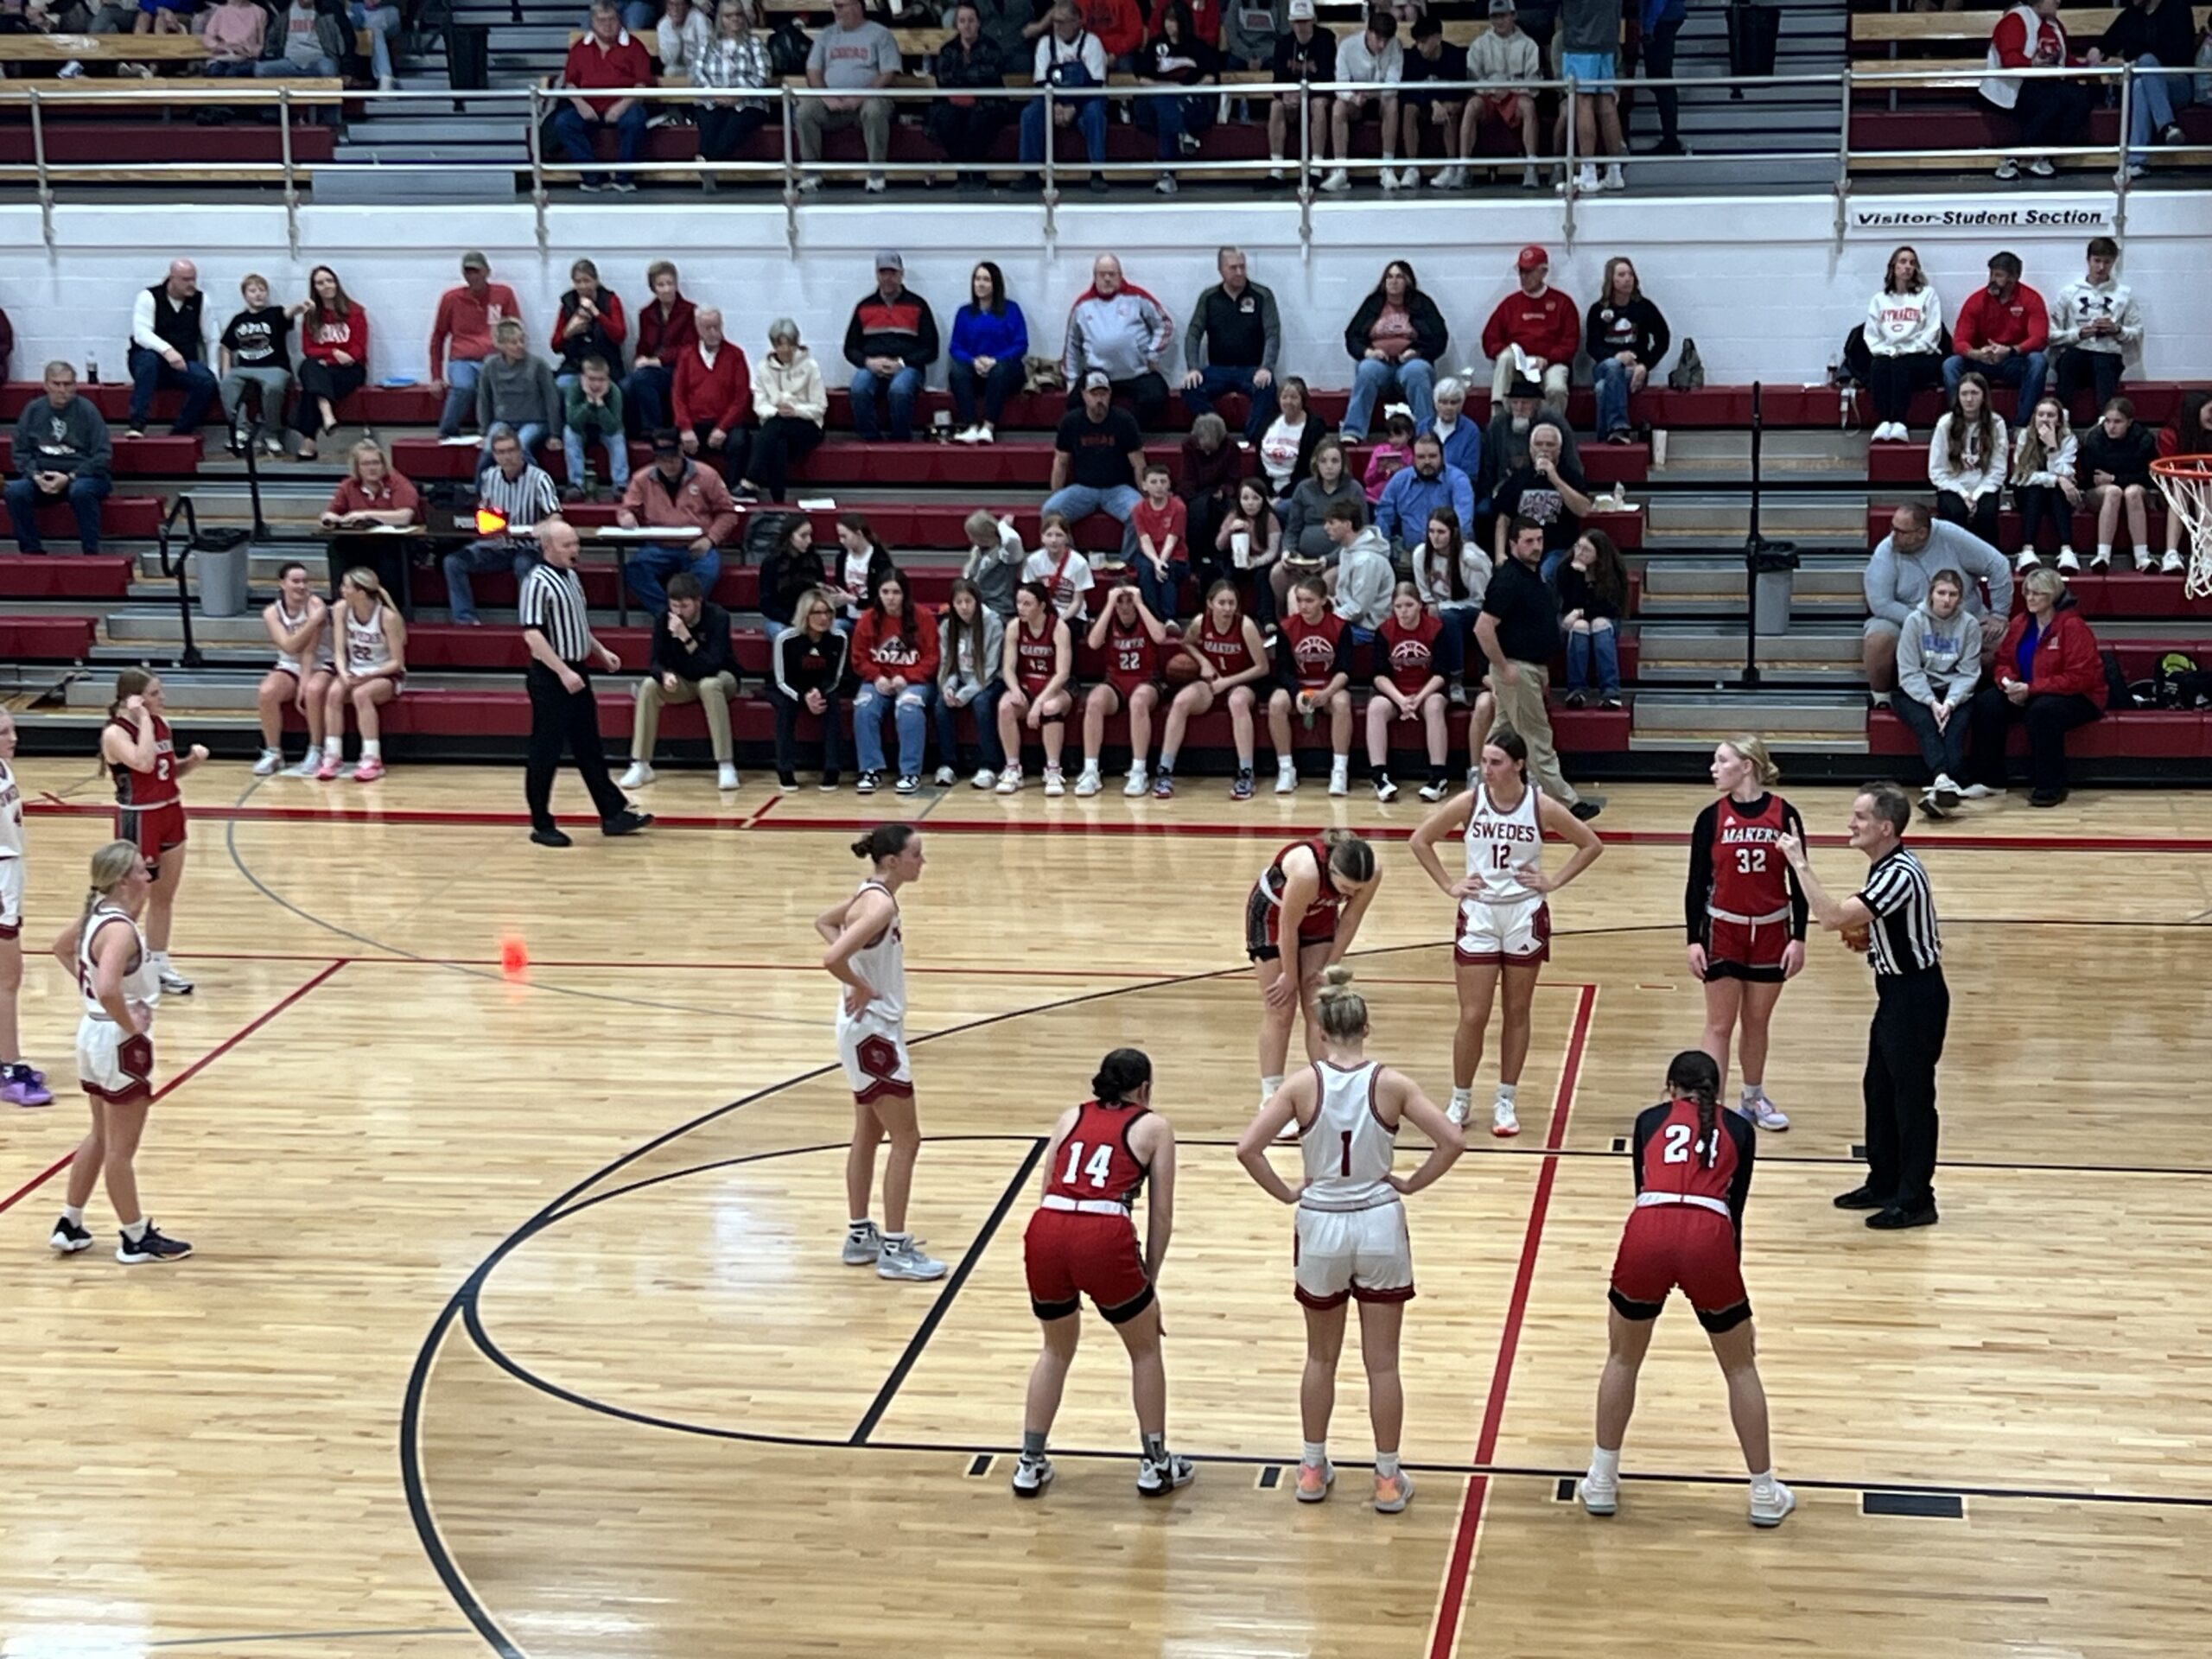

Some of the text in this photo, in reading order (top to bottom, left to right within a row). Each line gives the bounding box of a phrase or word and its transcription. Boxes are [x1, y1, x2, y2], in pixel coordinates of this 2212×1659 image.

[1858, 210, 2101, 225] Visitor-Student Section
[1119, 652, 1141, 671] 22
[157, 759, 170, 781] 2
[1471, 822, 1535, 842] SWEDES
[1721, 827, 1781, 844] MAKERS
[1491, 843, 1511, 869] 12
[1735, 849, 1767, 874] 32
[1062, 1141, 1114, 1188] 14
[1340, 1129, 1352, 1178] 1
